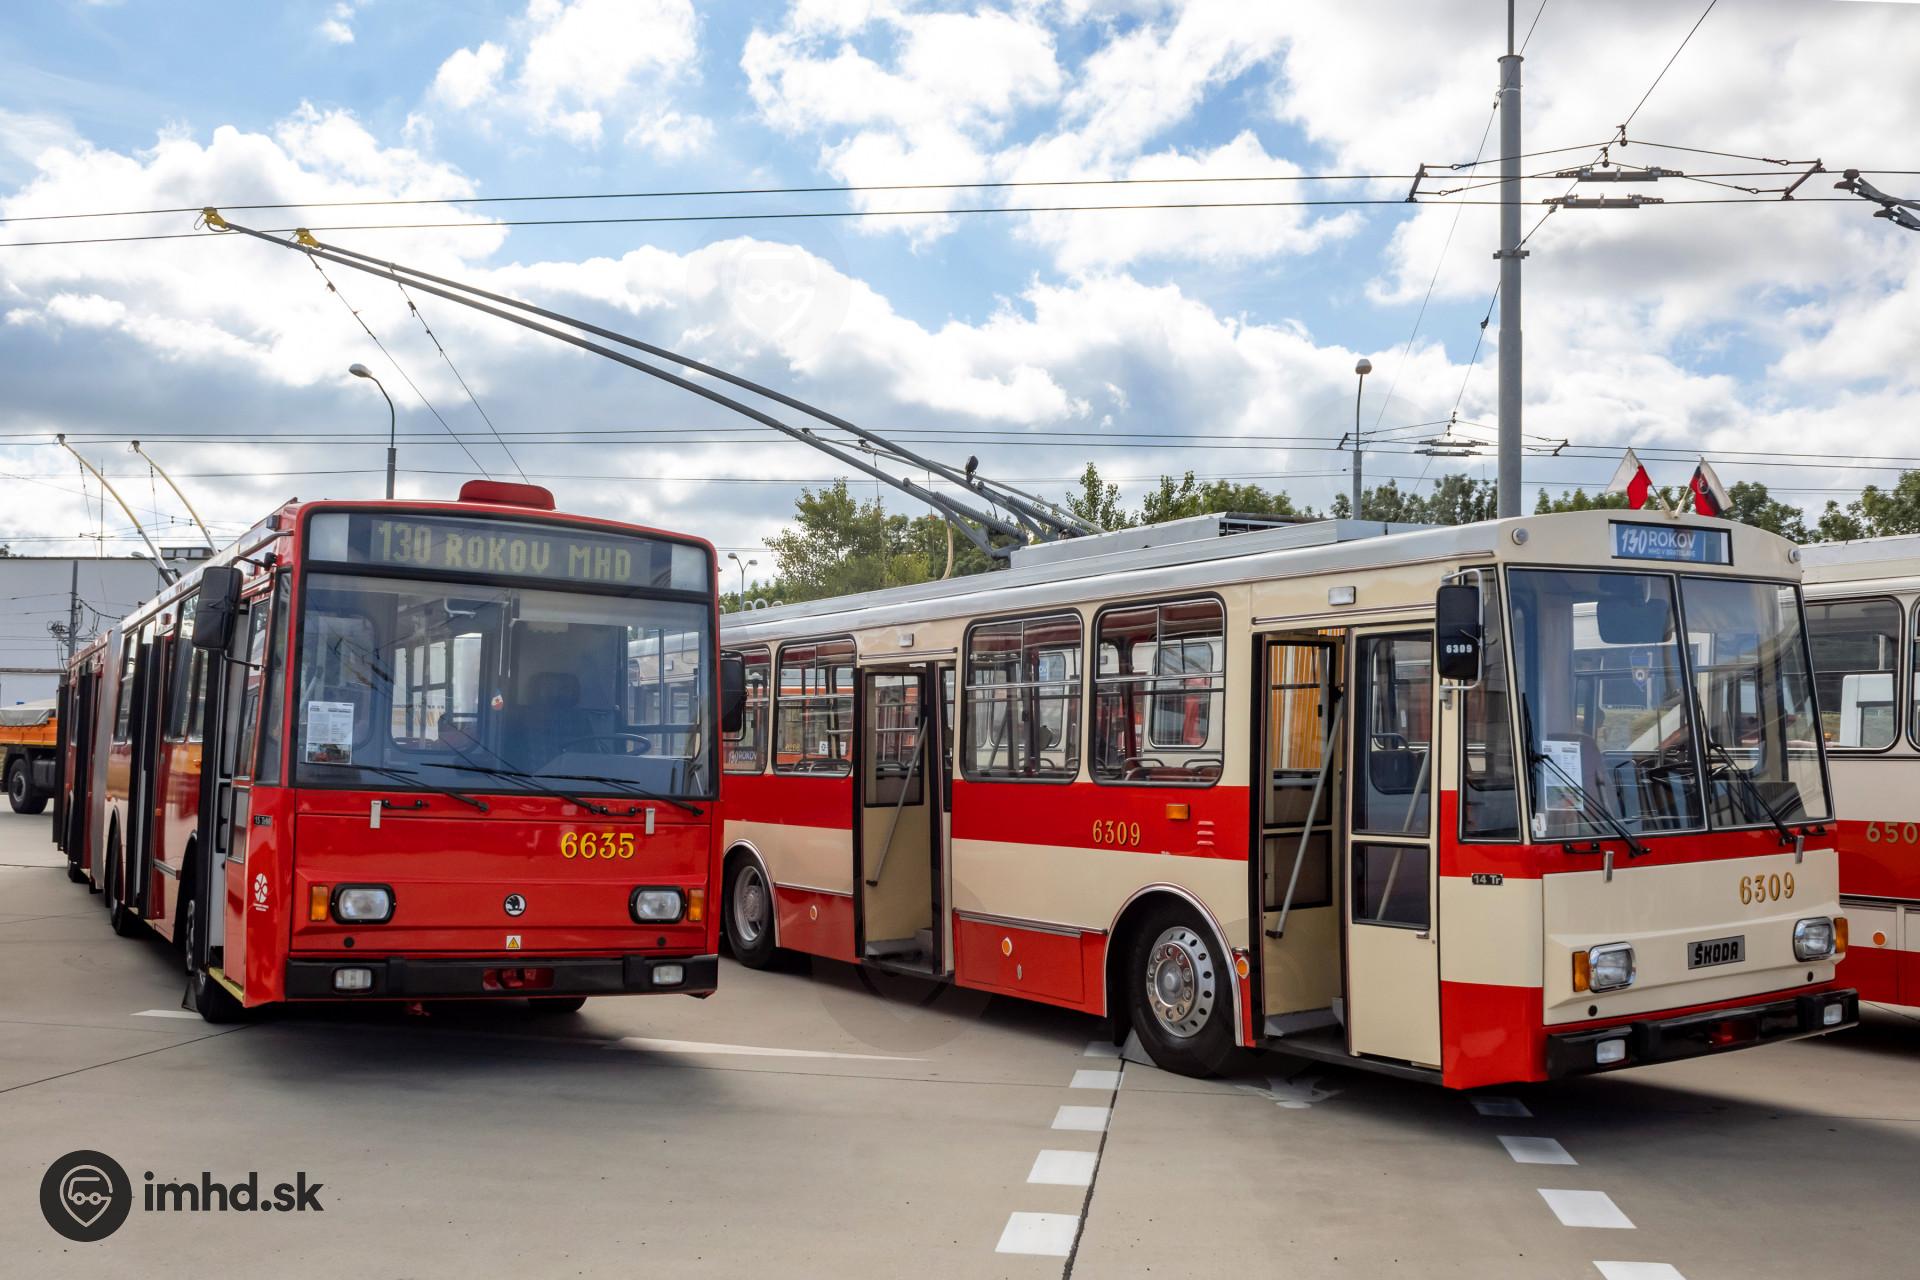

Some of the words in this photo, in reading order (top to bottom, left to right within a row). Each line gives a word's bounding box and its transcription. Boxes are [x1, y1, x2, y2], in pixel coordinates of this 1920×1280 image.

[377, 520, 432, 564] 130
[445, 533, 549, 573] ROKOV
[567, 544, 632, 582] MHD
[1622, 528, 1647, 554] 130
[1649, 531, 1696, 549] ROKOV
[1446, 644, 1472, 654] 6309
[560, 831, 635, 859] 6635
[1092, 819, 1141, 847] 6309
[1473, 875, 1487, 884] 14
[1489, 875, 1501, 885] Tr
[1739, 871, 1795, 905] 6309
[1693, 941, 1739, 966] ŠKODA
